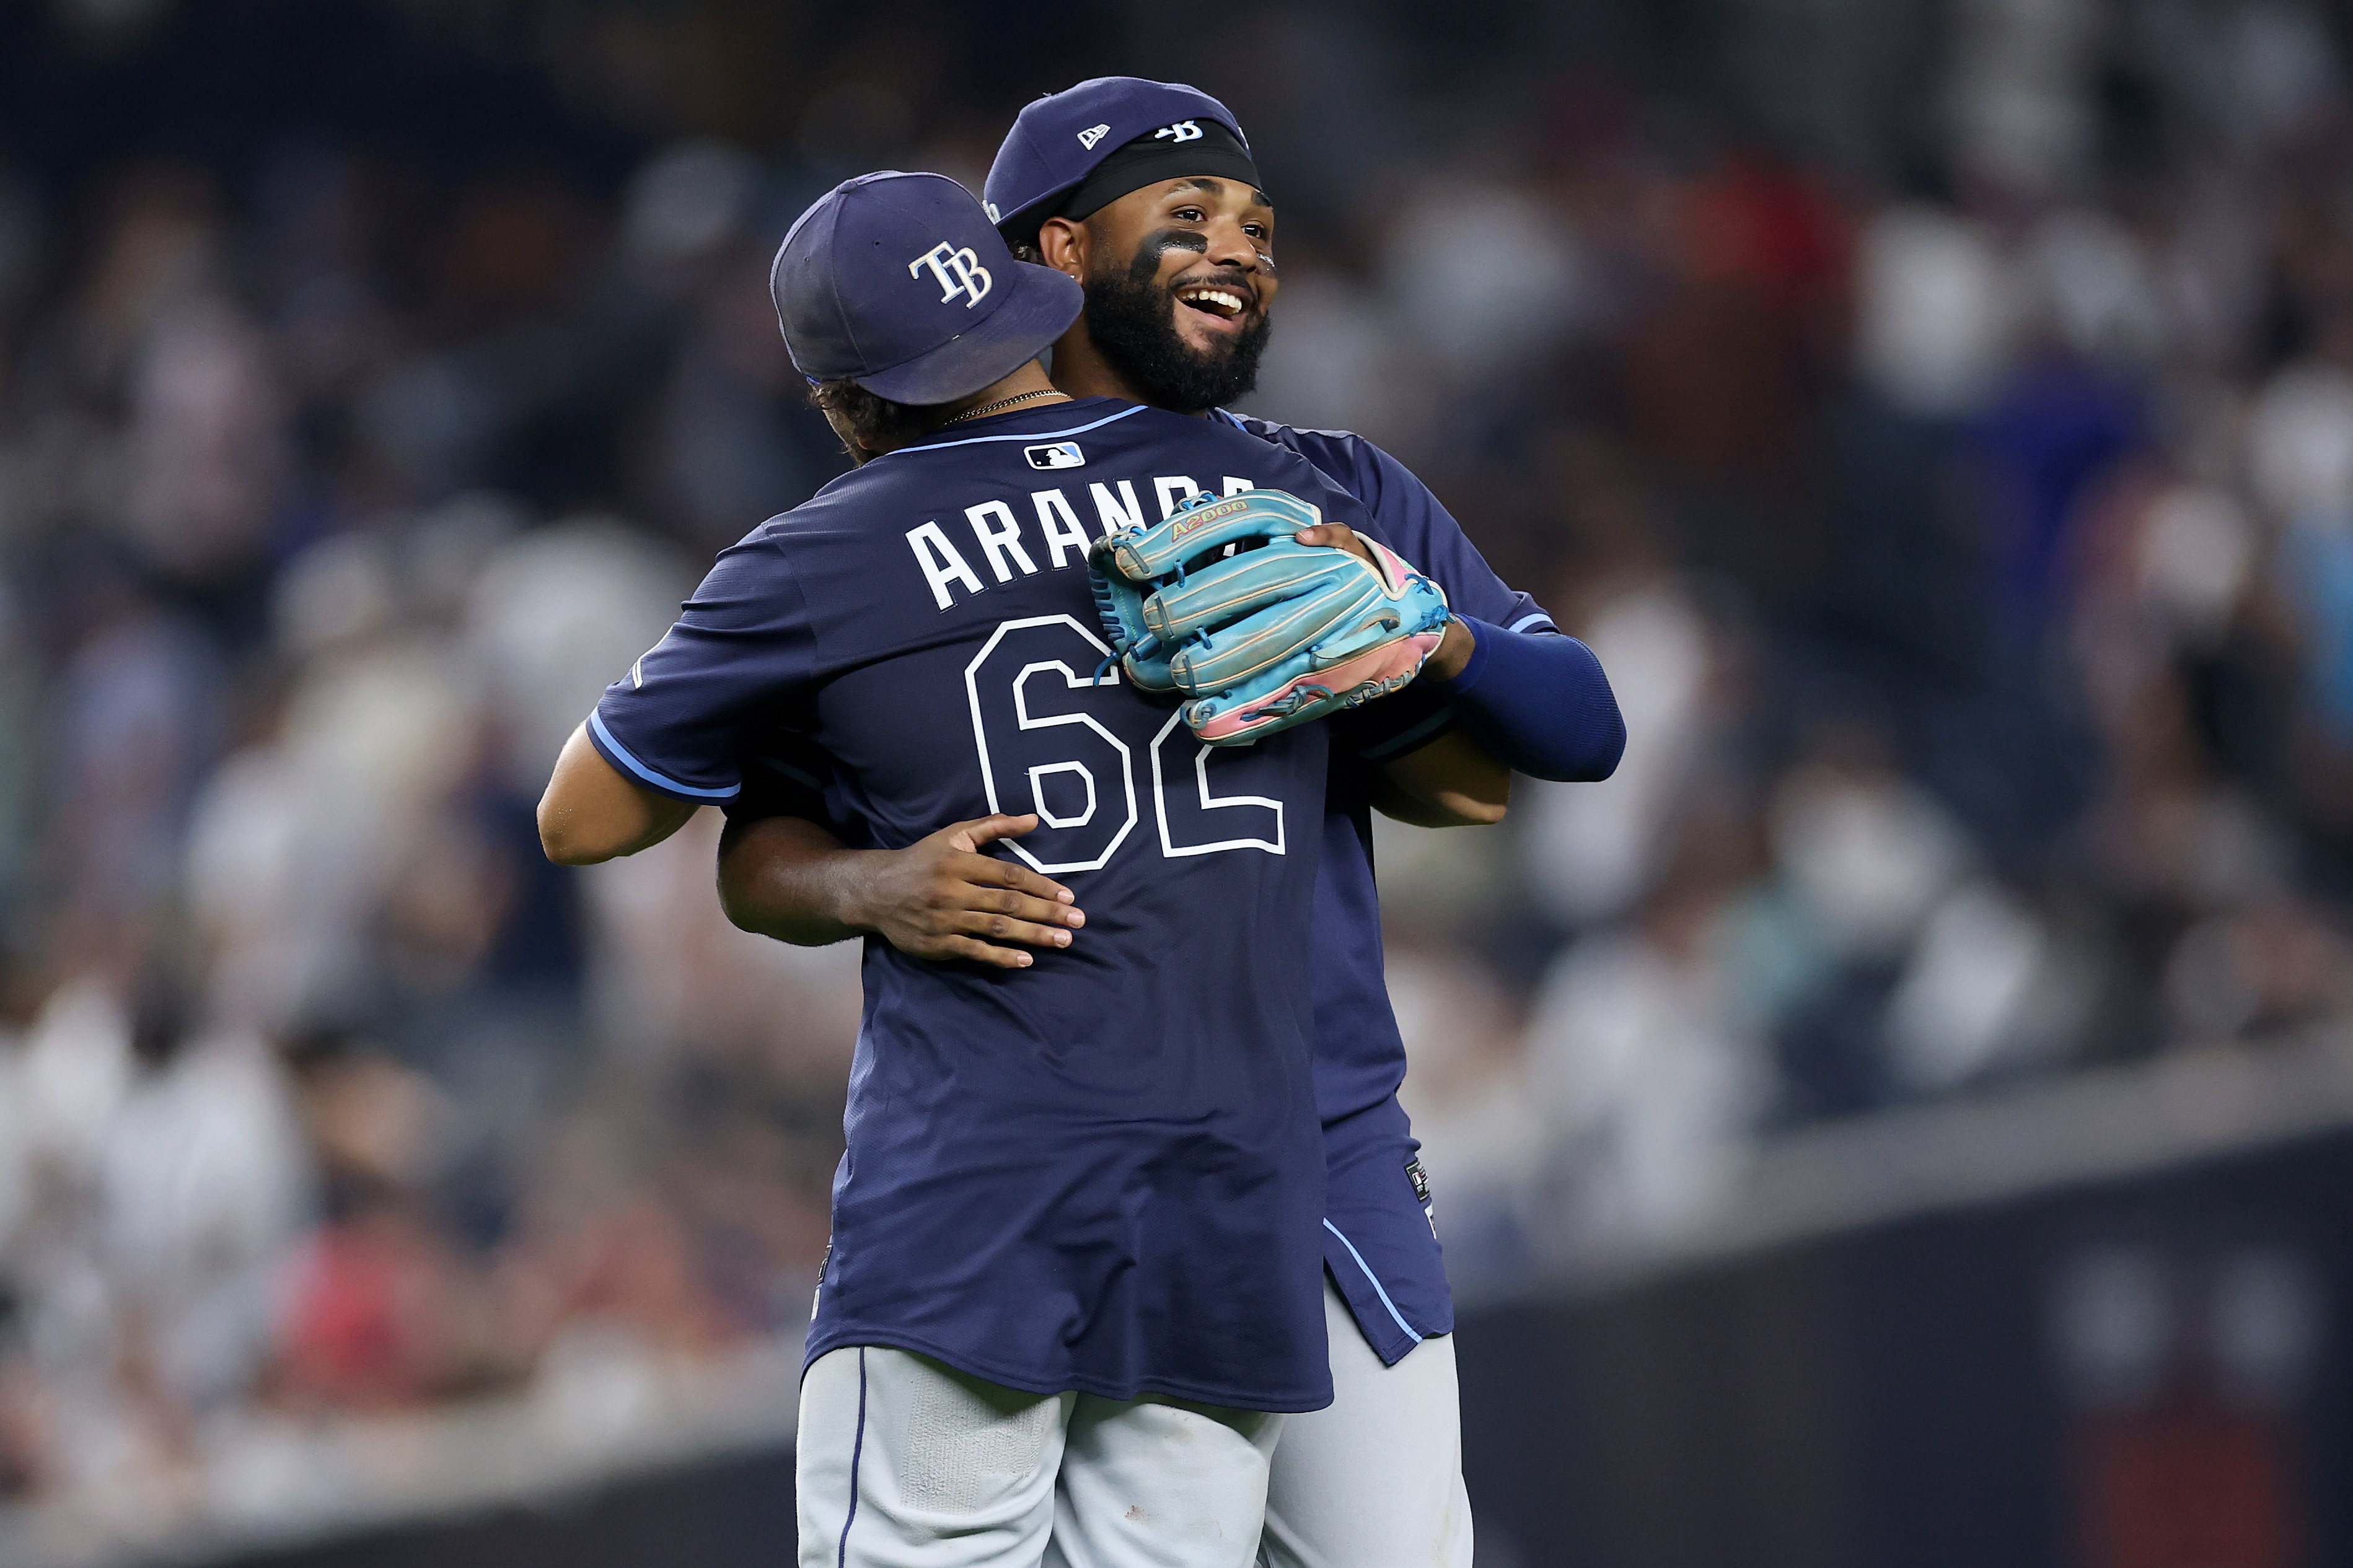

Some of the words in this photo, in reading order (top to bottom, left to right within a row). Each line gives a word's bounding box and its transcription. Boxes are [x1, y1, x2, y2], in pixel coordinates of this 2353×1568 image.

[908, 240, 992, 310] TB
[905, 475, 1256, 610] ARAN
[1172, 499, 1249, 543] A2000
[964, 614, 1286, 874] 62
